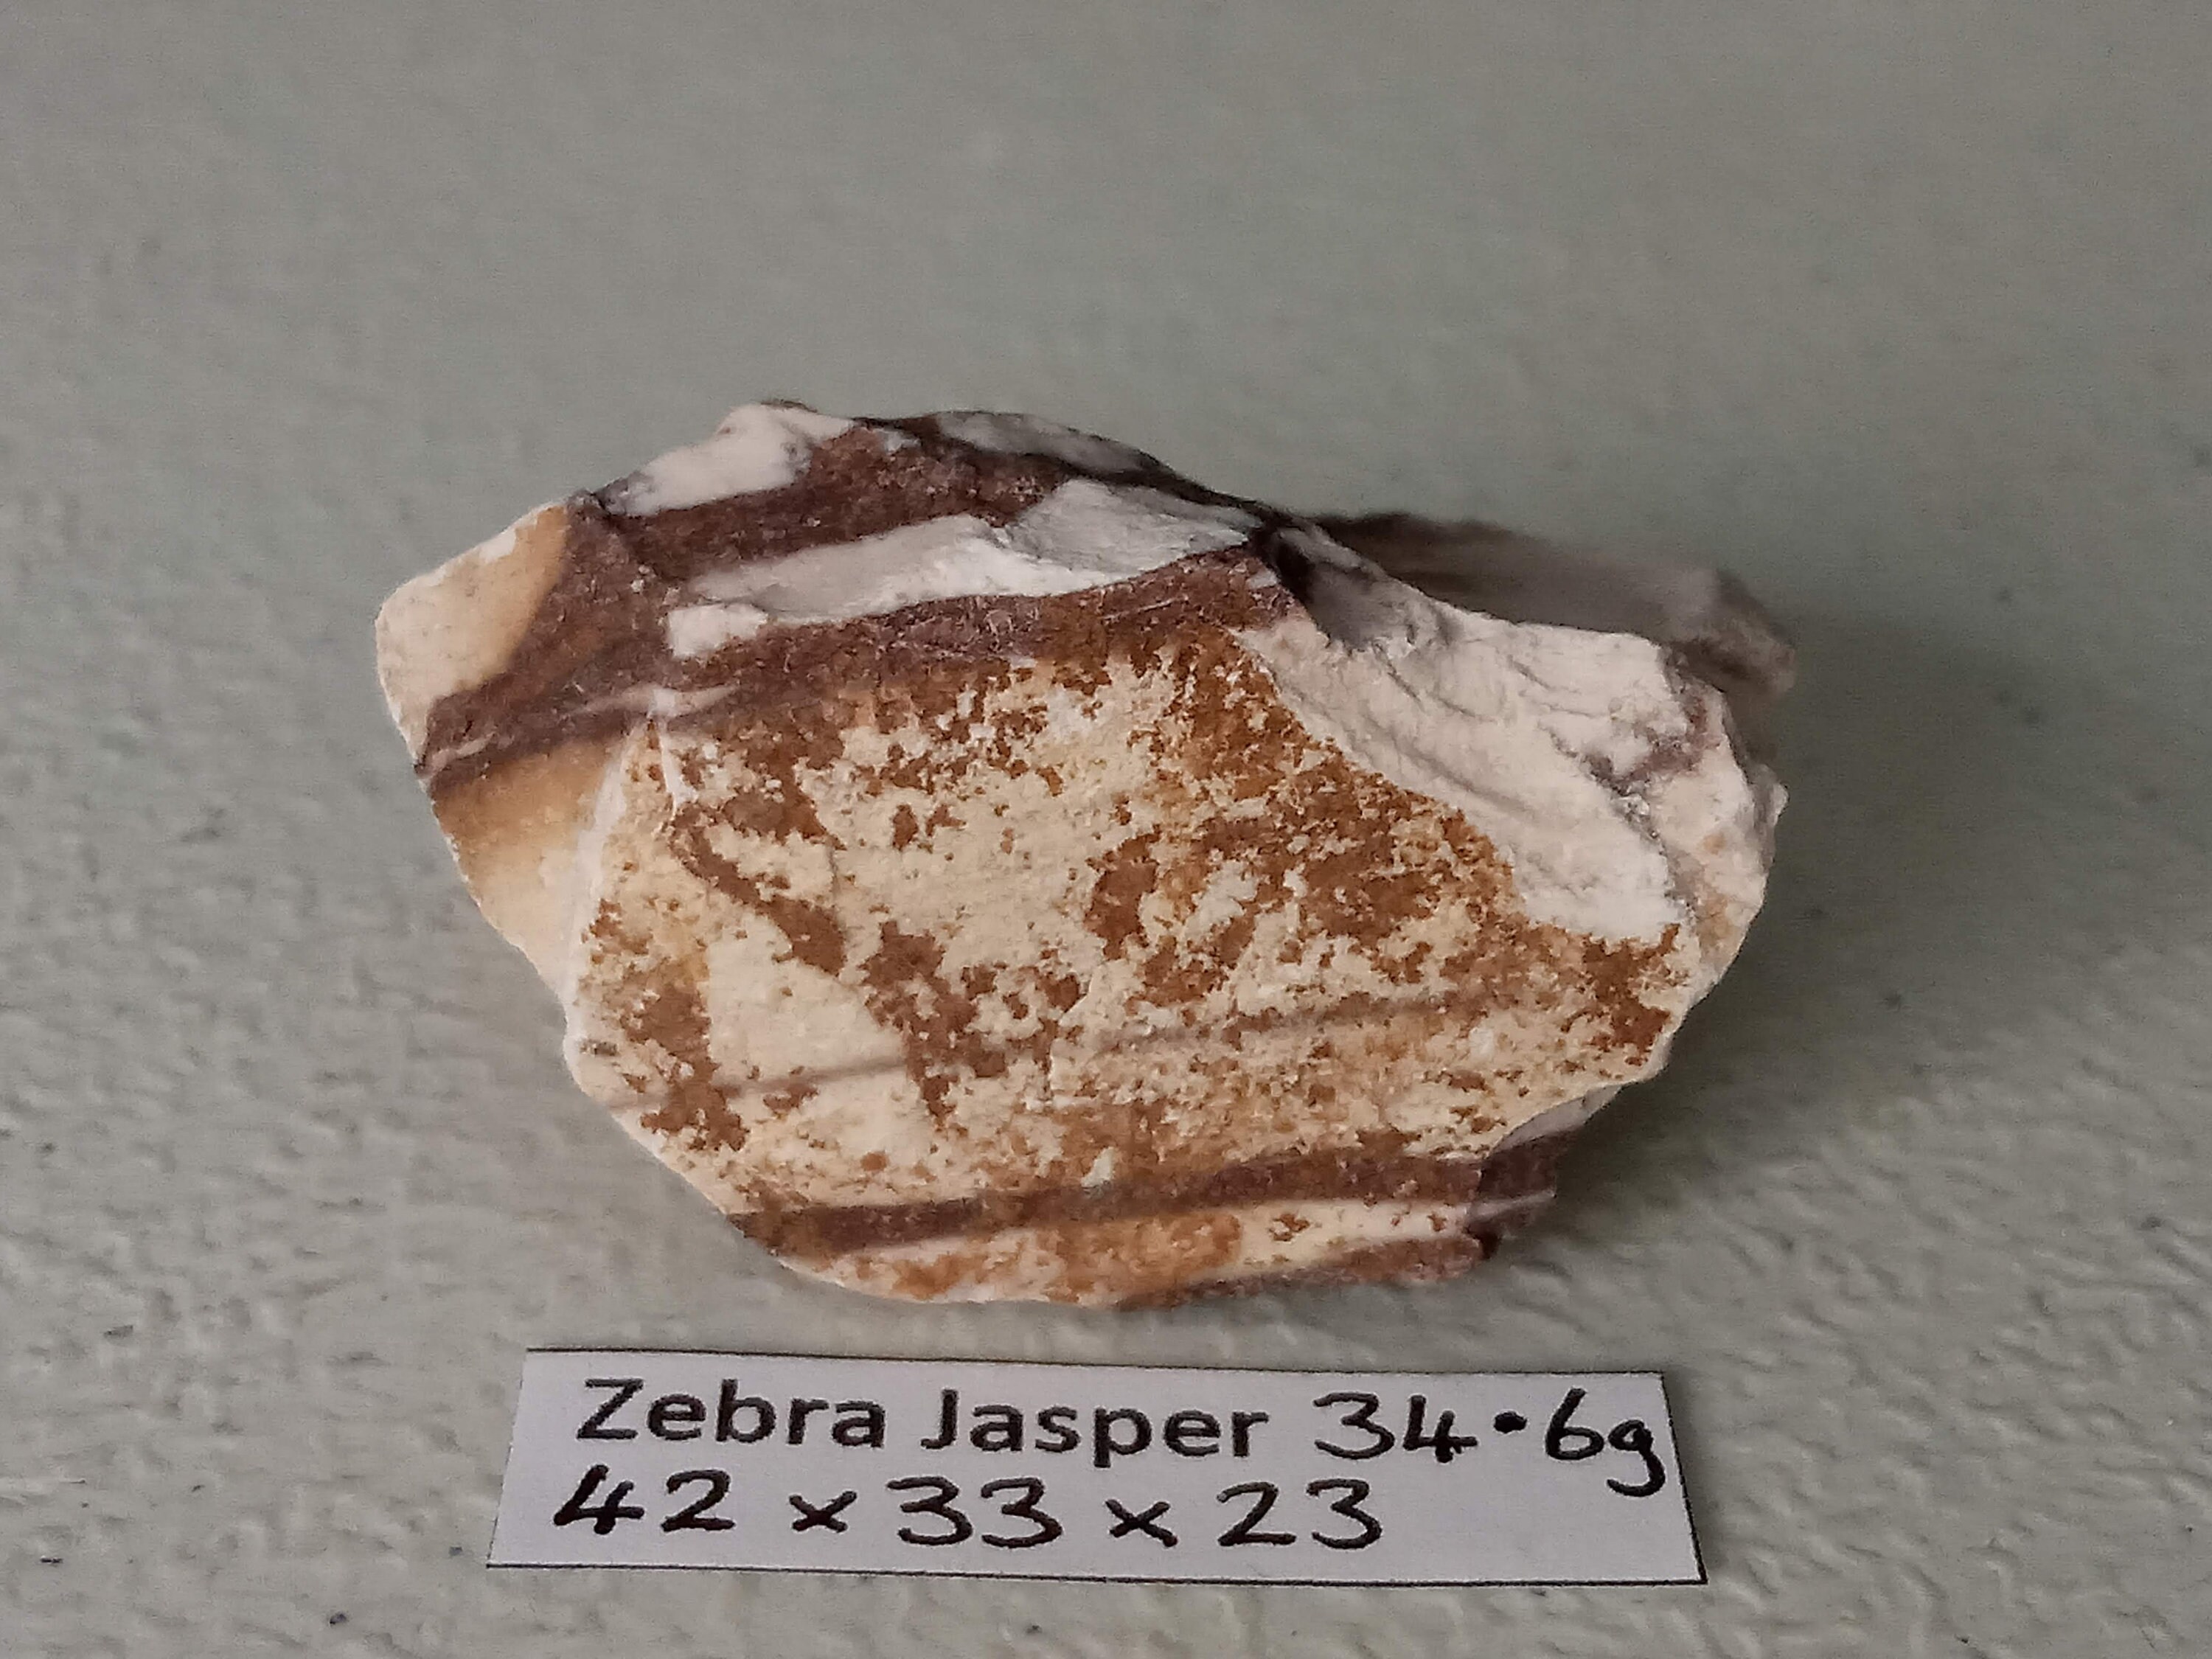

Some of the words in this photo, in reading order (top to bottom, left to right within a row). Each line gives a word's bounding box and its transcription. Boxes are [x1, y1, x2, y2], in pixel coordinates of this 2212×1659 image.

[575, 1378, 886, 1449] Zebra
[919, 1388, 1270, 1470] Jasper
[552, 1464, 736, 1537] 42
[886, 1475, 1063, 1551] 33
[1215, 1477, 1383, 1551] 23
